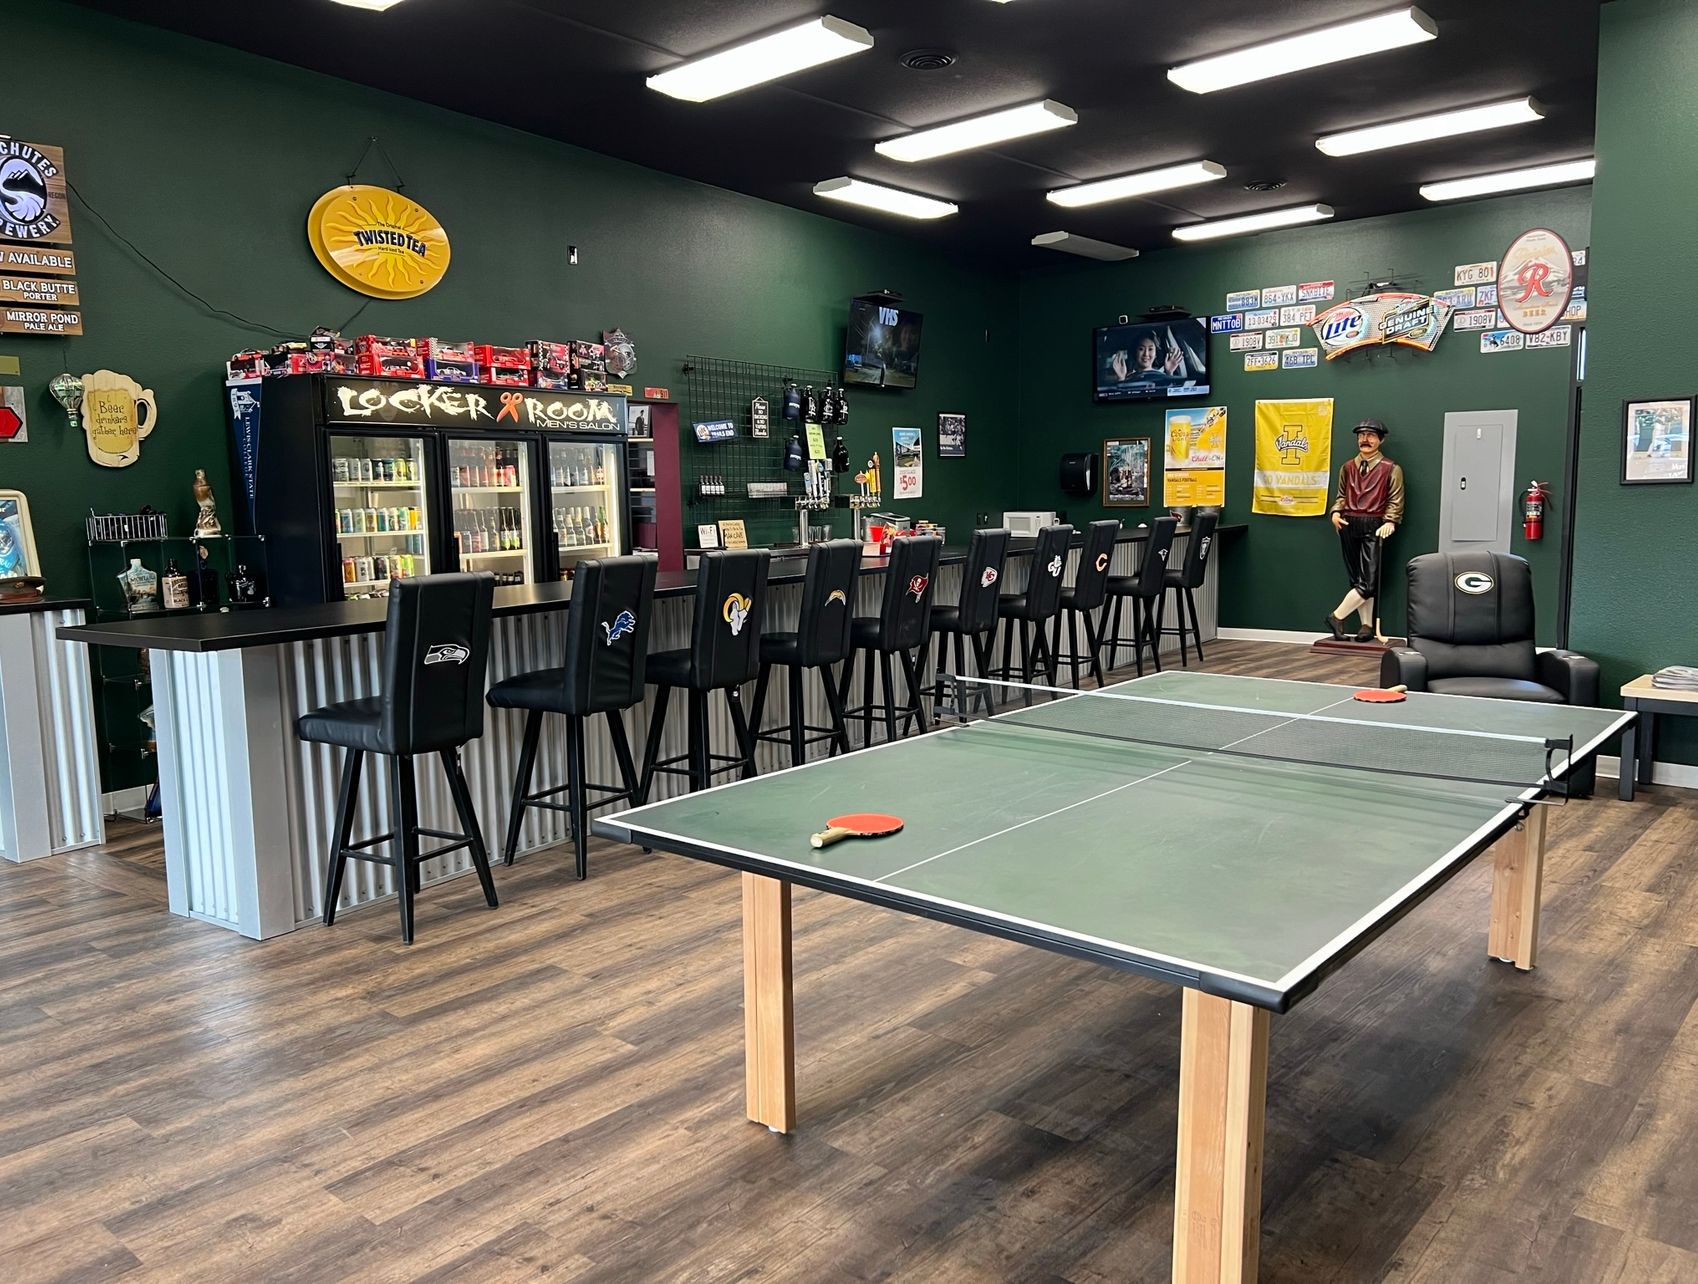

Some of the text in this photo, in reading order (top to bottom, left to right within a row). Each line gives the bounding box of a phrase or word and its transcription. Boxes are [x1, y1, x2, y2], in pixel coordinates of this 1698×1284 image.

[353, 230, 428, 257] TWISTED TEA
[8, 252, 73, 268] AVAILABLE
[1457, 266, 1494, 282] KYG 801
[3, 280, 76, 294] BLACK BUTTE
[1514, 262, 1554, 304] R
[23, 291, 58, 301] PORTER
[6, 311, 79, 324] MIRROR POND
[879, 306, 899, 327] VHS
[1379, 304, 1435, 330] GENUINE
[24, 322, 65, 331] PALE ALE
[1386, 315, 1427, 335] DRAFT
[98, 400, 125, 414] Beer
[337, 384, 618, 424] LOCKER ROOM
[92, 425, 137, 438] gather here
[536, 420, 620, 431] MEN'S SALON
[707, 423, 728, 431] WELCOME
[1275, 434, 1309, 453] Vandals
[1276, 473, 1317, 486] VANDALS
